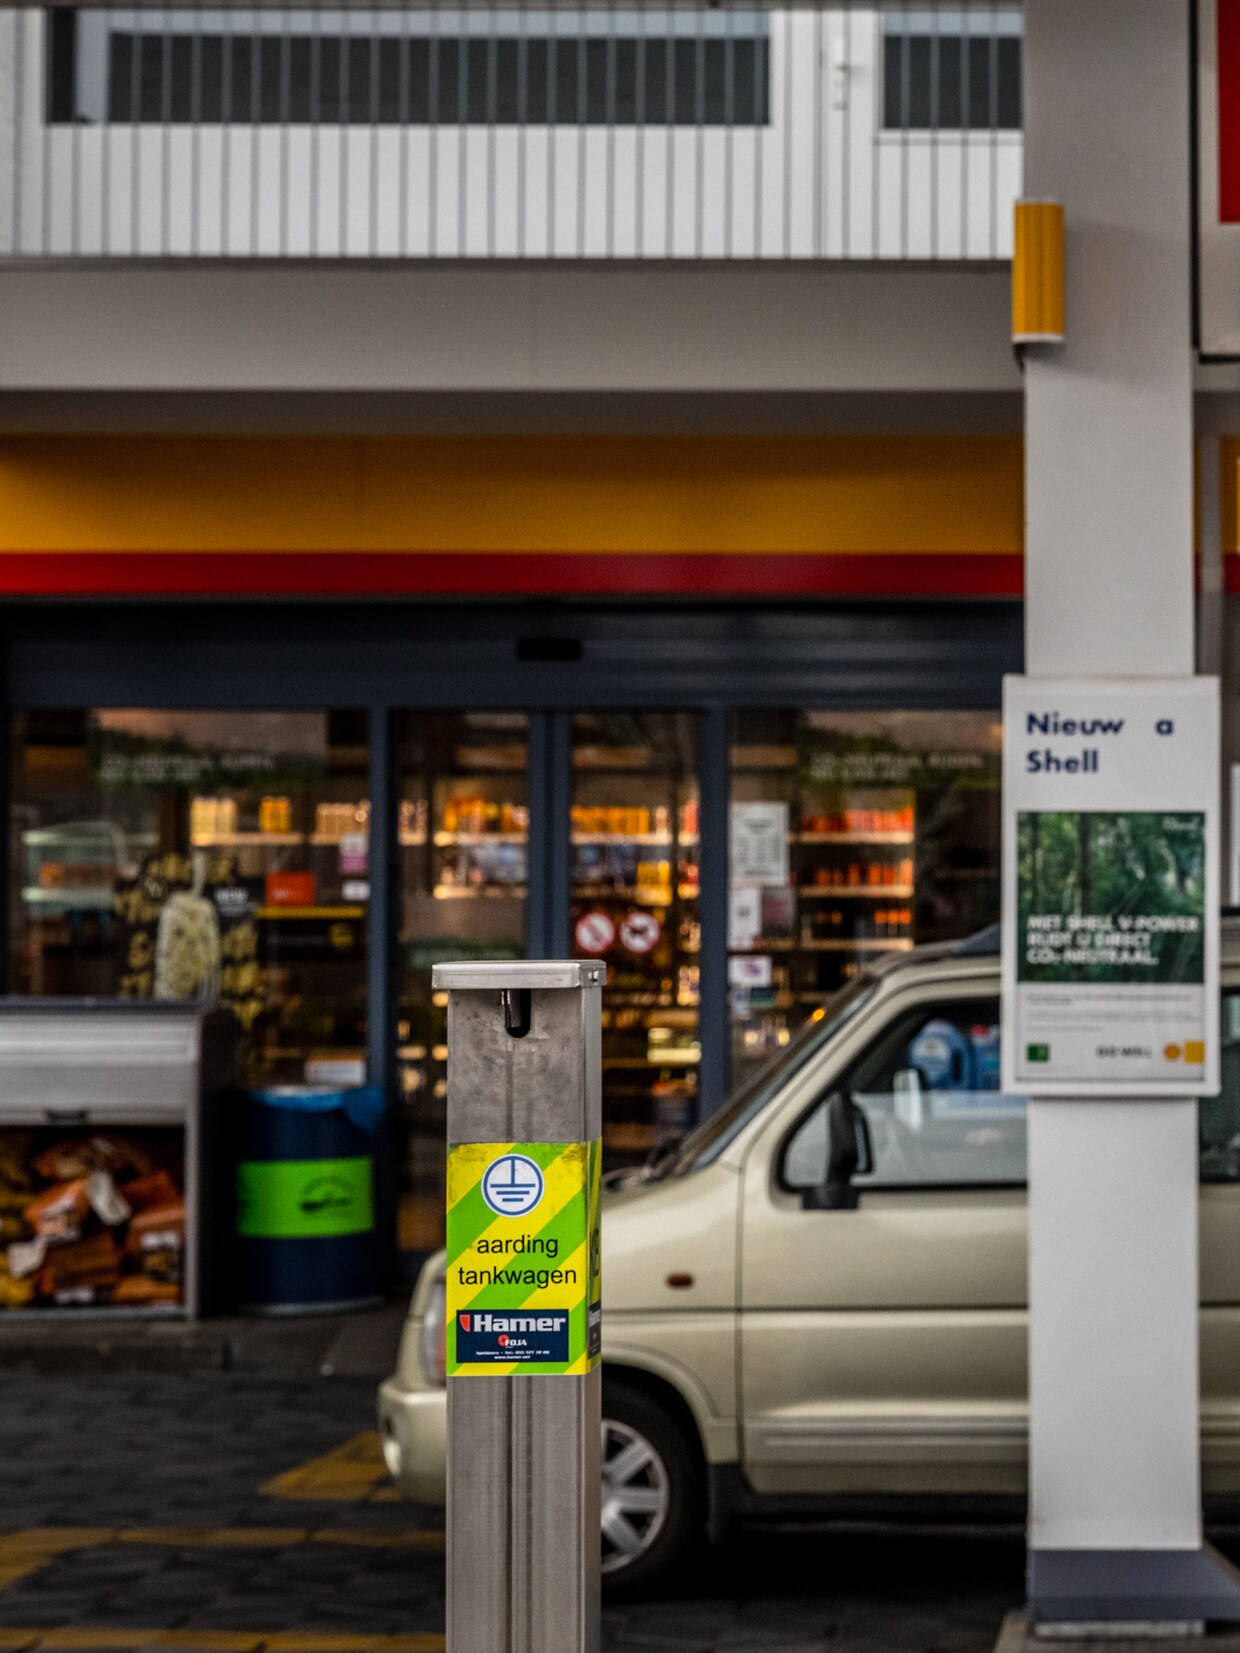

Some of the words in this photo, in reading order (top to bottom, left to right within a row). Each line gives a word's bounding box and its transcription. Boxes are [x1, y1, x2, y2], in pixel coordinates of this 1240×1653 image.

[1026, 712, 1124, 736] Nieuw
[1026, 749, 1099, 773] Shell
[477, 1235, 559, 1258] aarding
[458, 1266, 577, 1289] tankwagen
[473, 1314, 567, 1332] Hamer
